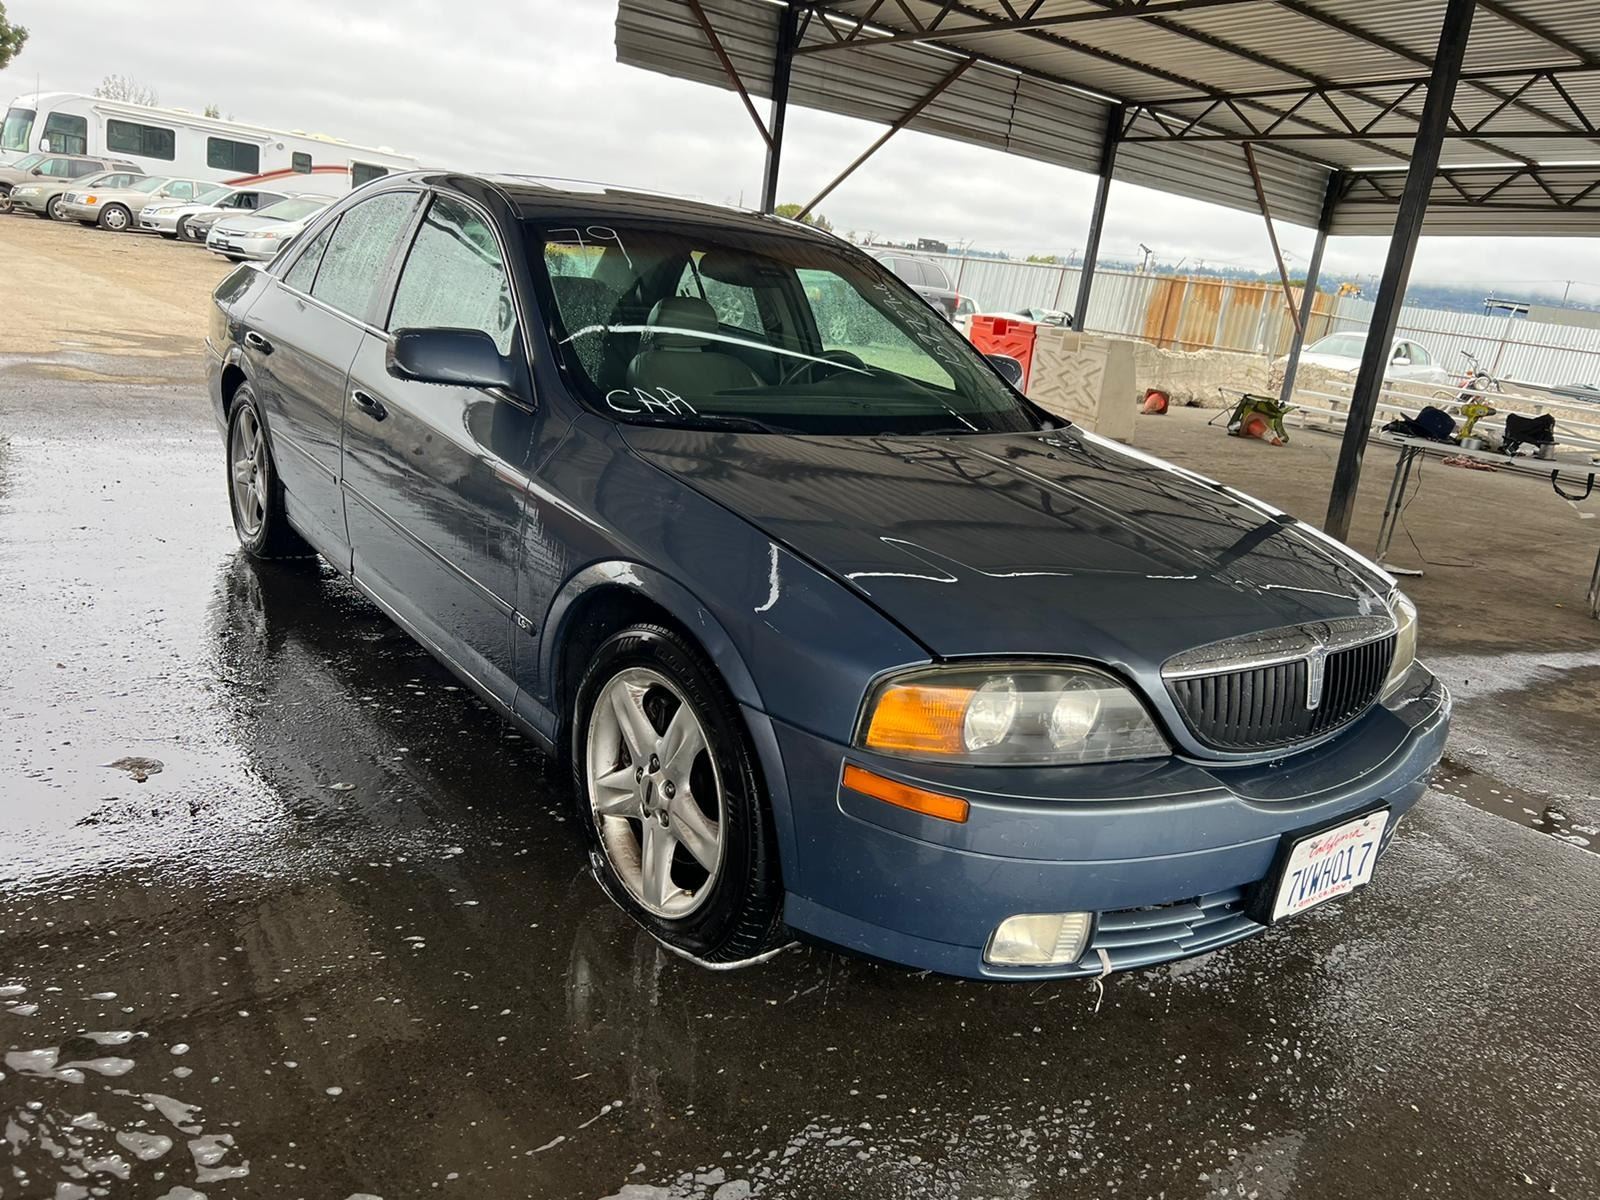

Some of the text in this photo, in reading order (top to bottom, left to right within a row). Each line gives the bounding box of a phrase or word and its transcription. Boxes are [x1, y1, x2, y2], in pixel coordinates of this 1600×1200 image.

[547, 225, 633, 271] 79
[605, 386, 698, 416] CAA
[1308, 828, 1366, 858] California
[1287, 842, 1373, 906] 7VWH017
